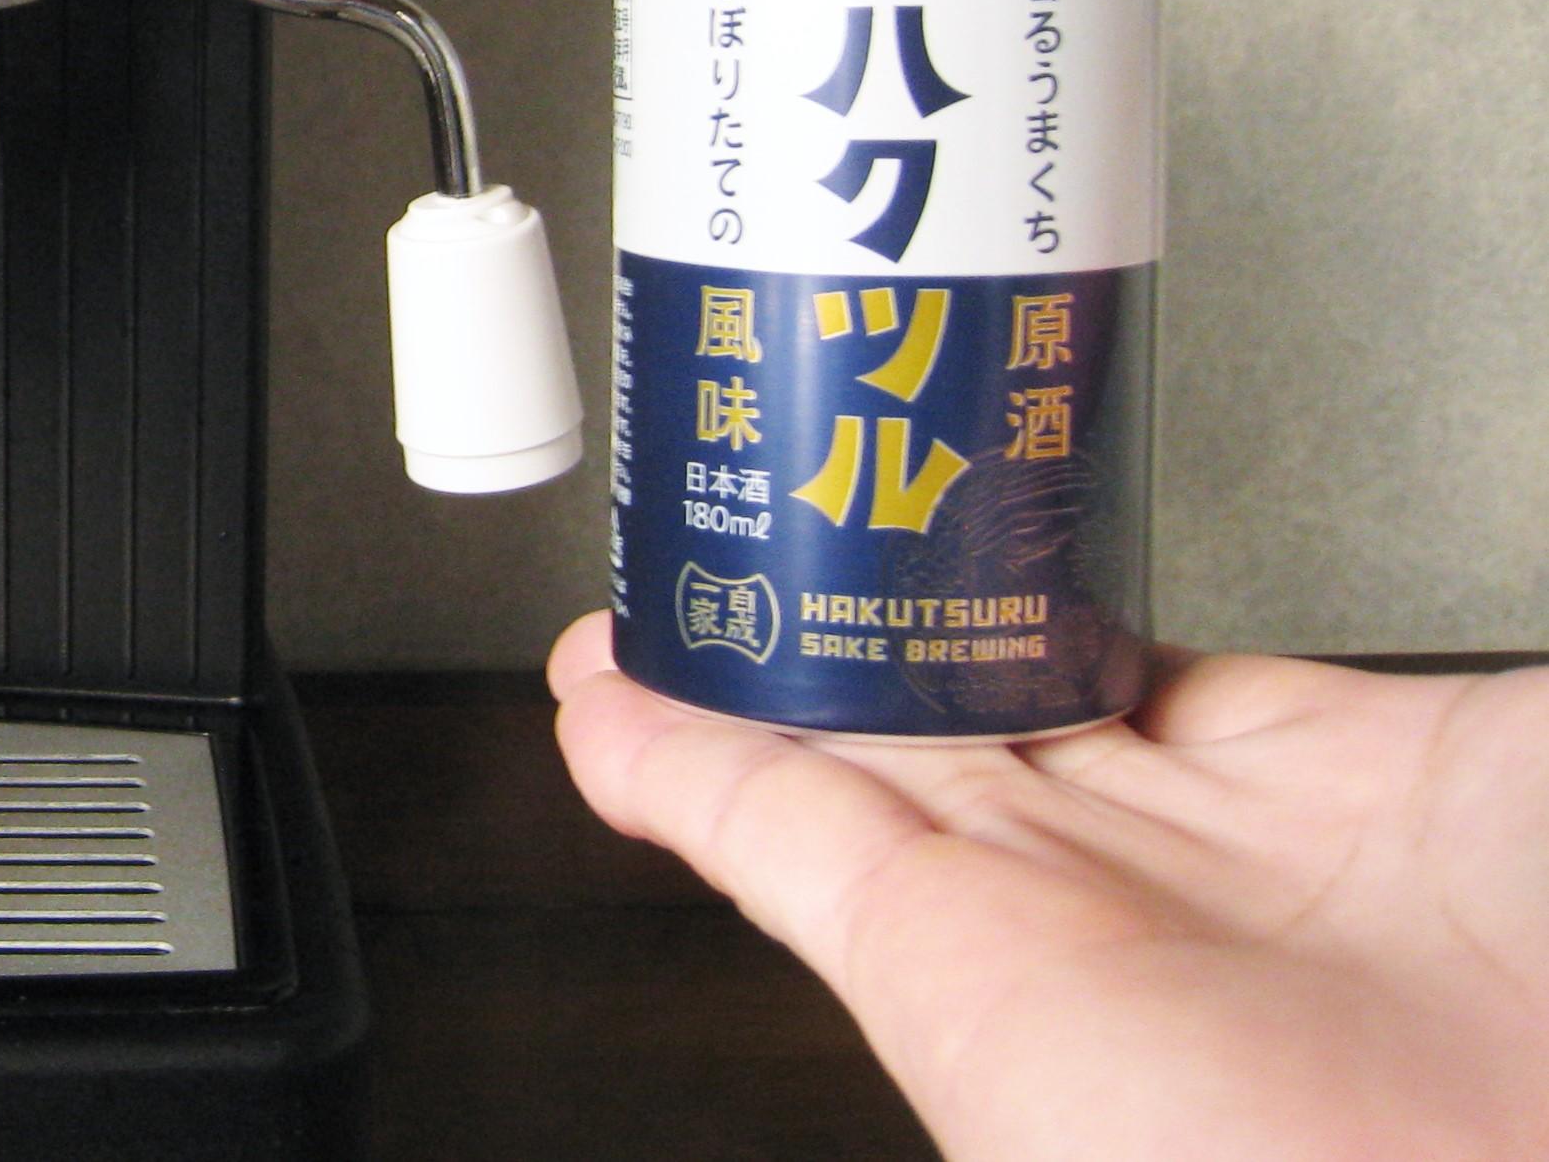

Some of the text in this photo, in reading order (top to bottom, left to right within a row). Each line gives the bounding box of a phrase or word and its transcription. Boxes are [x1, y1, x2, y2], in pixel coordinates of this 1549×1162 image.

[695, 285, 762, 452] 風味
[1004, 292, 1075, 460] 原酒
[685, 461, 772, 505] 日本酒
[799, 591, 1049, 629] HAKUTSURU
[799, 632, 1049, 664] SAKE BREWING
